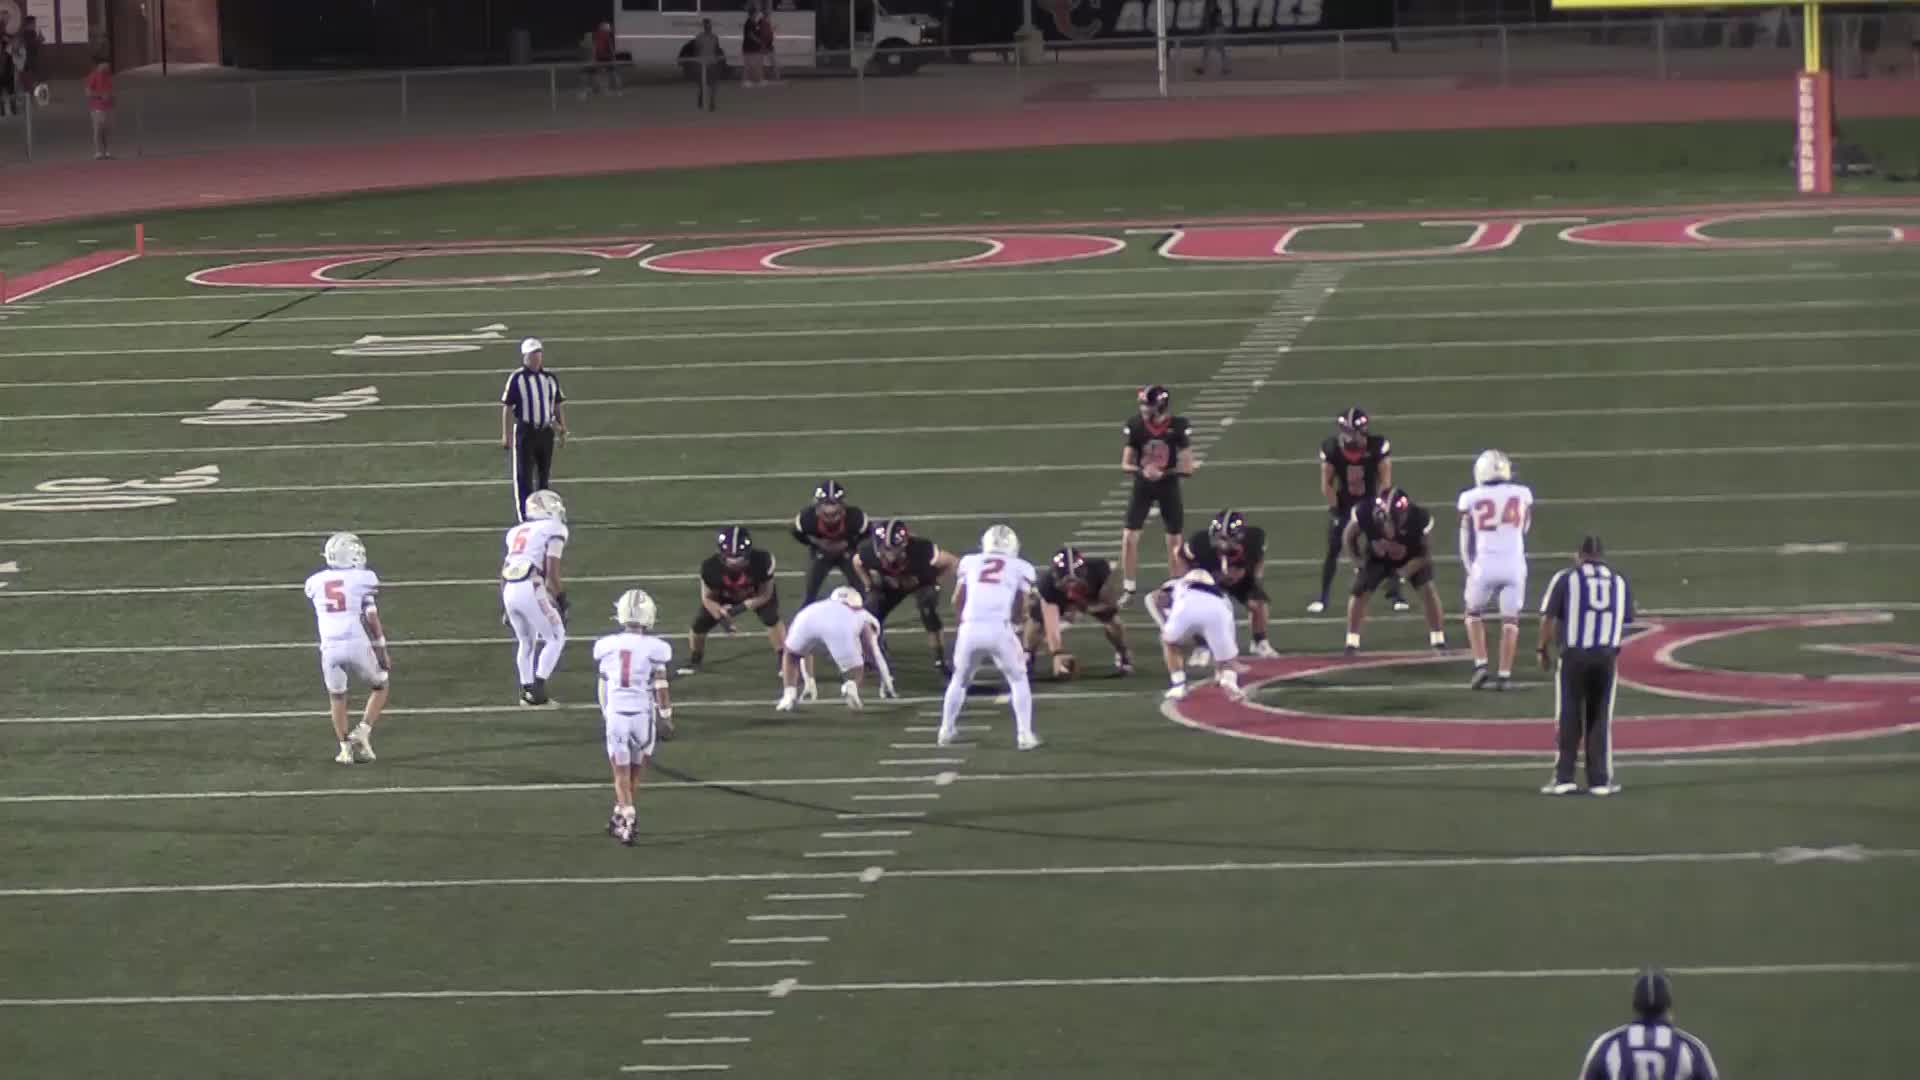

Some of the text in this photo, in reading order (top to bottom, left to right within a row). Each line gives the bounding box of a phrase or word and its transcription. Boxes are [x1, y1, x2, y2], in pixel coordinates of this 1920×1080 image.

[1475, 496, 1521, 531] 24
[978, 558, 1006, 584] 2
[324, 579, 347, 613] 5
[1587, 577, 1612, 610] U
[619, 649, 633, 688] 1
